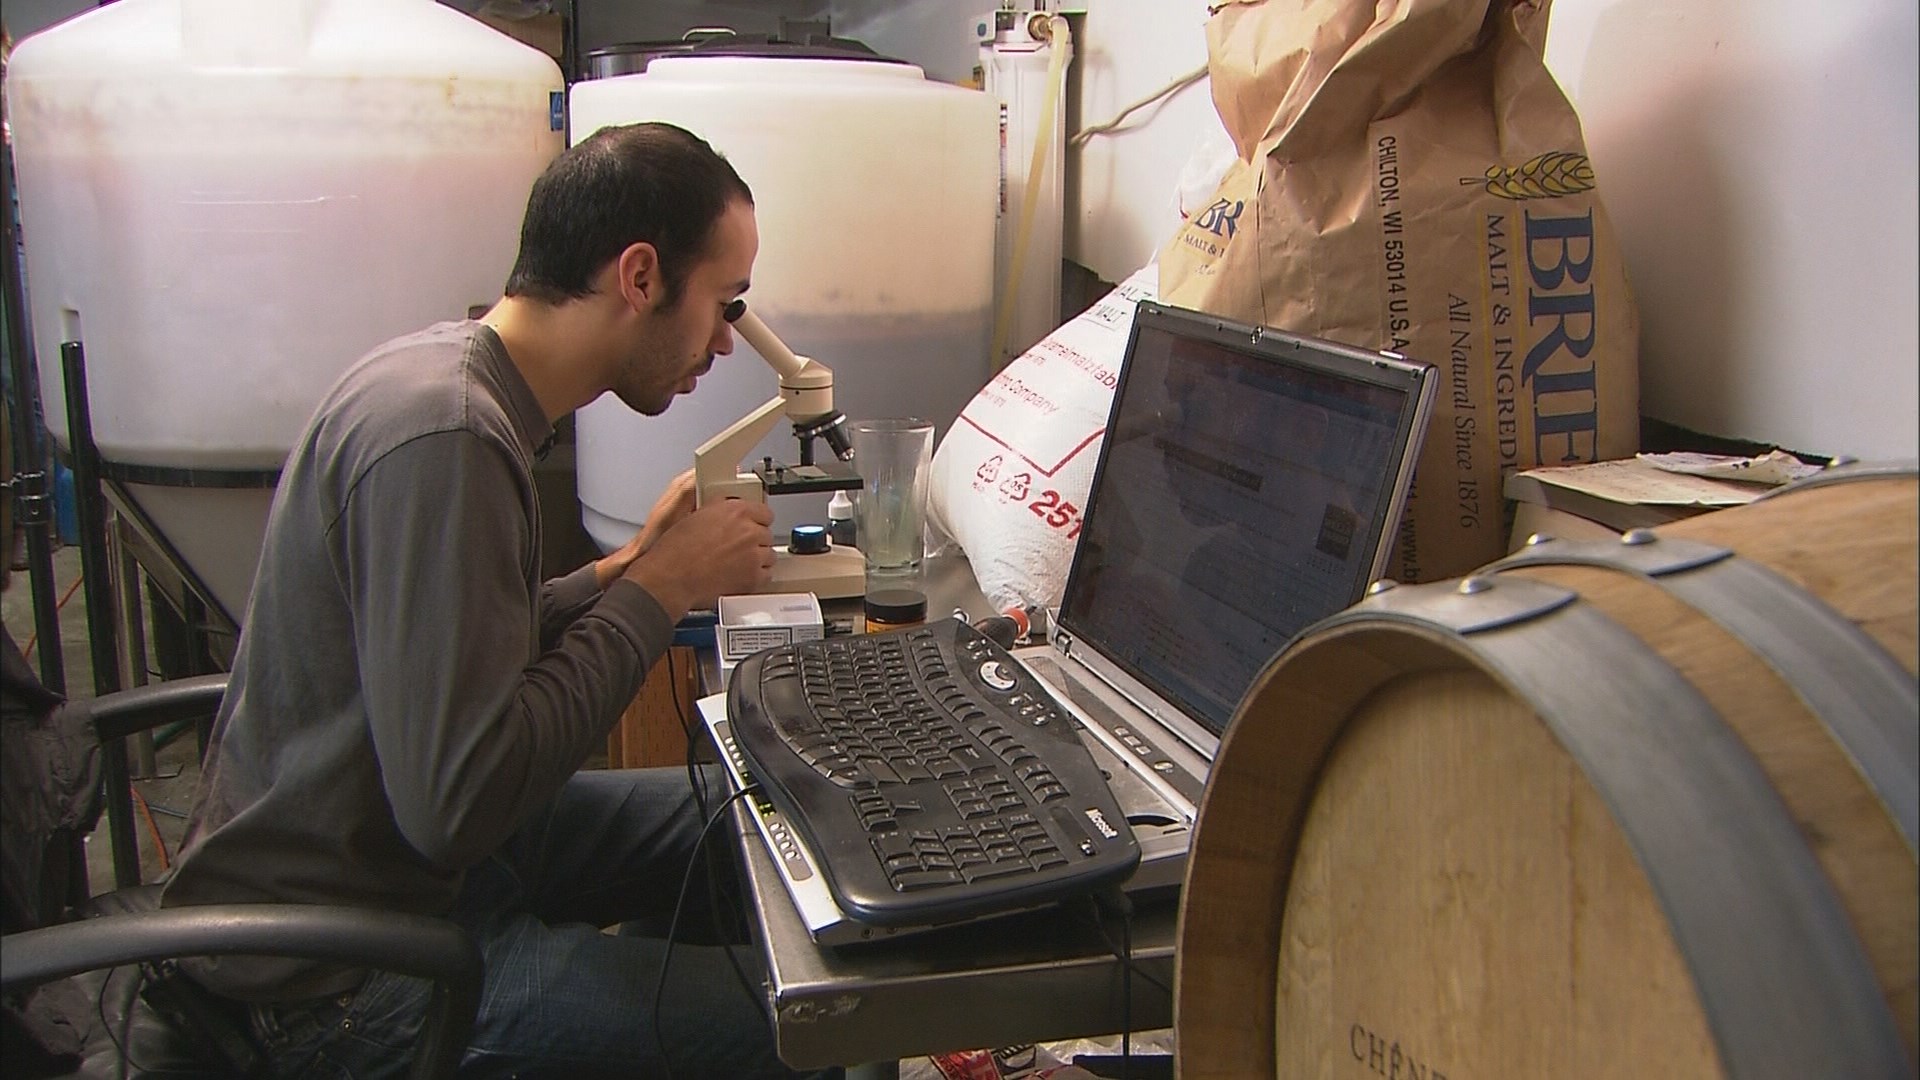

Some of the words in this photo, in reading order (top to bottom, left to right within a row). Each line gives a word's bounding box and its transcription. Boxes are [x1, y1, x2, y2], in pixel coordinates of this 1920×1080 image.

[1378, 136, 1400, 207] CHILTON,
[1383, 211, 1403, 234] WI
[1385, 240, 1406, 293] 53014
[1487, 214, 1509, 296] MALT
[1448, 293, 1472, 322] All
[1492, 303, 1512, 326] &
[1450, 328, 1476, 410] Natural
[1454, 415, 1476, 471] Since
[1458, 481, 1480, 529] 1876
